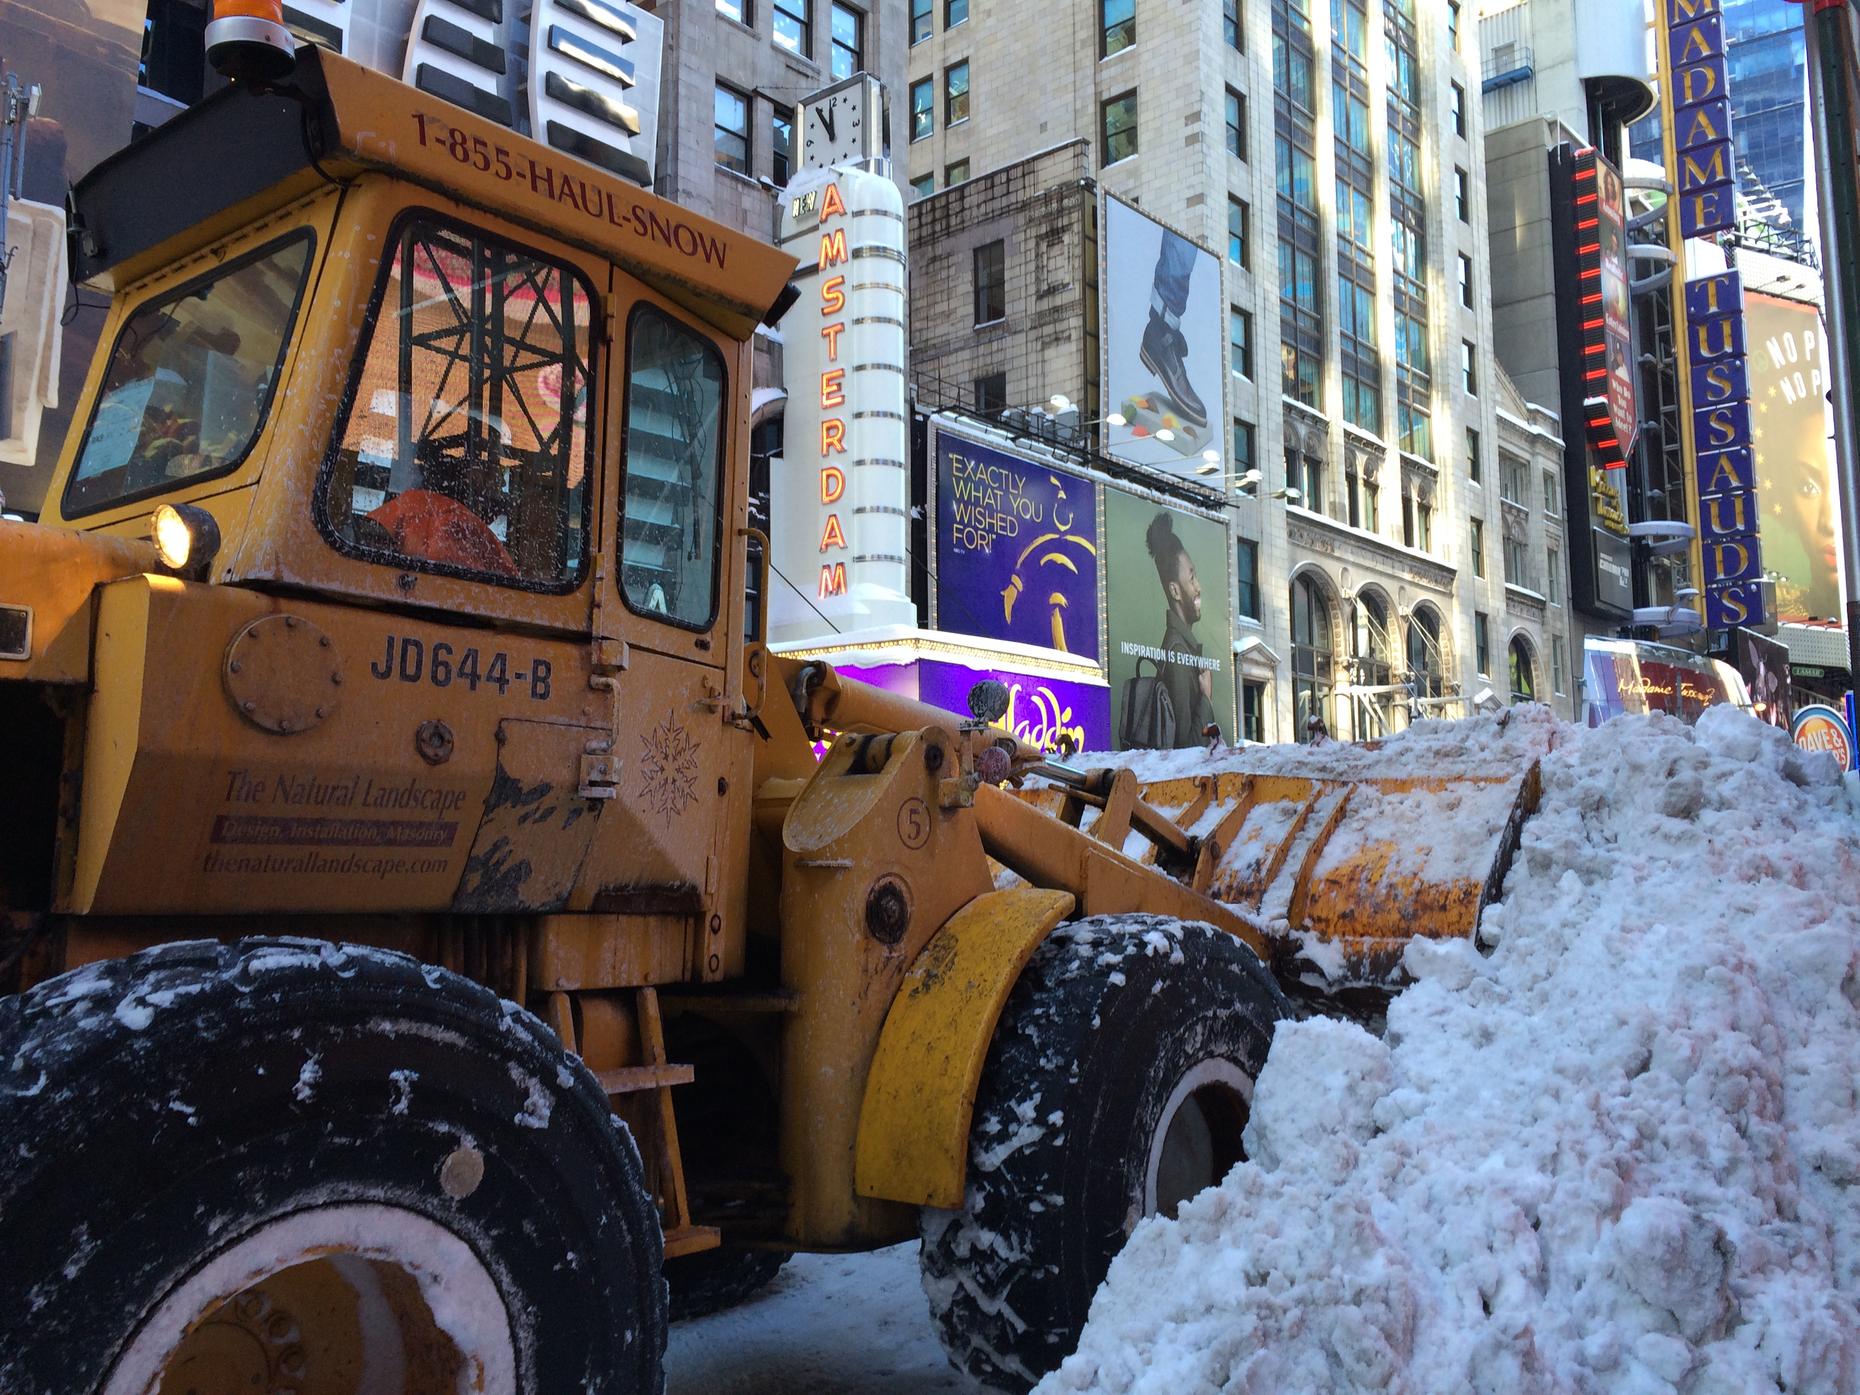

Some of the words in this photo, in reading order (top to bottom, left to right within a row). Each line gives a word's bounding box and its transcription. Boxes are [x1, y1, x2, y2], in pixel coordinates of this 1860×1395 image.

[1672, 0, 1726, 229] MADAME
[411, 113, 727, 270] 1-855-HAUL-SNOW
[793, 191, 817, 218] NEW
[1766, 331, 1798, 369] NO
[817, 182, 848, 600] AMSTERDAM
[1780, 371, 1807, 405] NO
[1694, 276, 1750, 625] TUSSAUD'S
[952, 477, 1003, 511] WHAT
[1009, 494, 1043, 523] YOU
[952, 500, 1019, 537] WISHED
[370, 634, 552, 701] JD644-B
[1121, 641, 1166, 661] INSPIRATION
[1168, 649, 1175, 663] IS
[1177, 652, 1221, 672] EVERYWHERE
[988, 682, 1085, 754] laddin
[1799, 727, 1833, 753] DAVE
[225, 768, 266, 804] The
[272, 772, 360, 806] Natural
[361, 777, 467, 821] Landscape
[387, 825, 448, 844] Masonry
[908, 808, 920, 840] 5
[203, 850, 448, 880] thenaturallandscape.com
